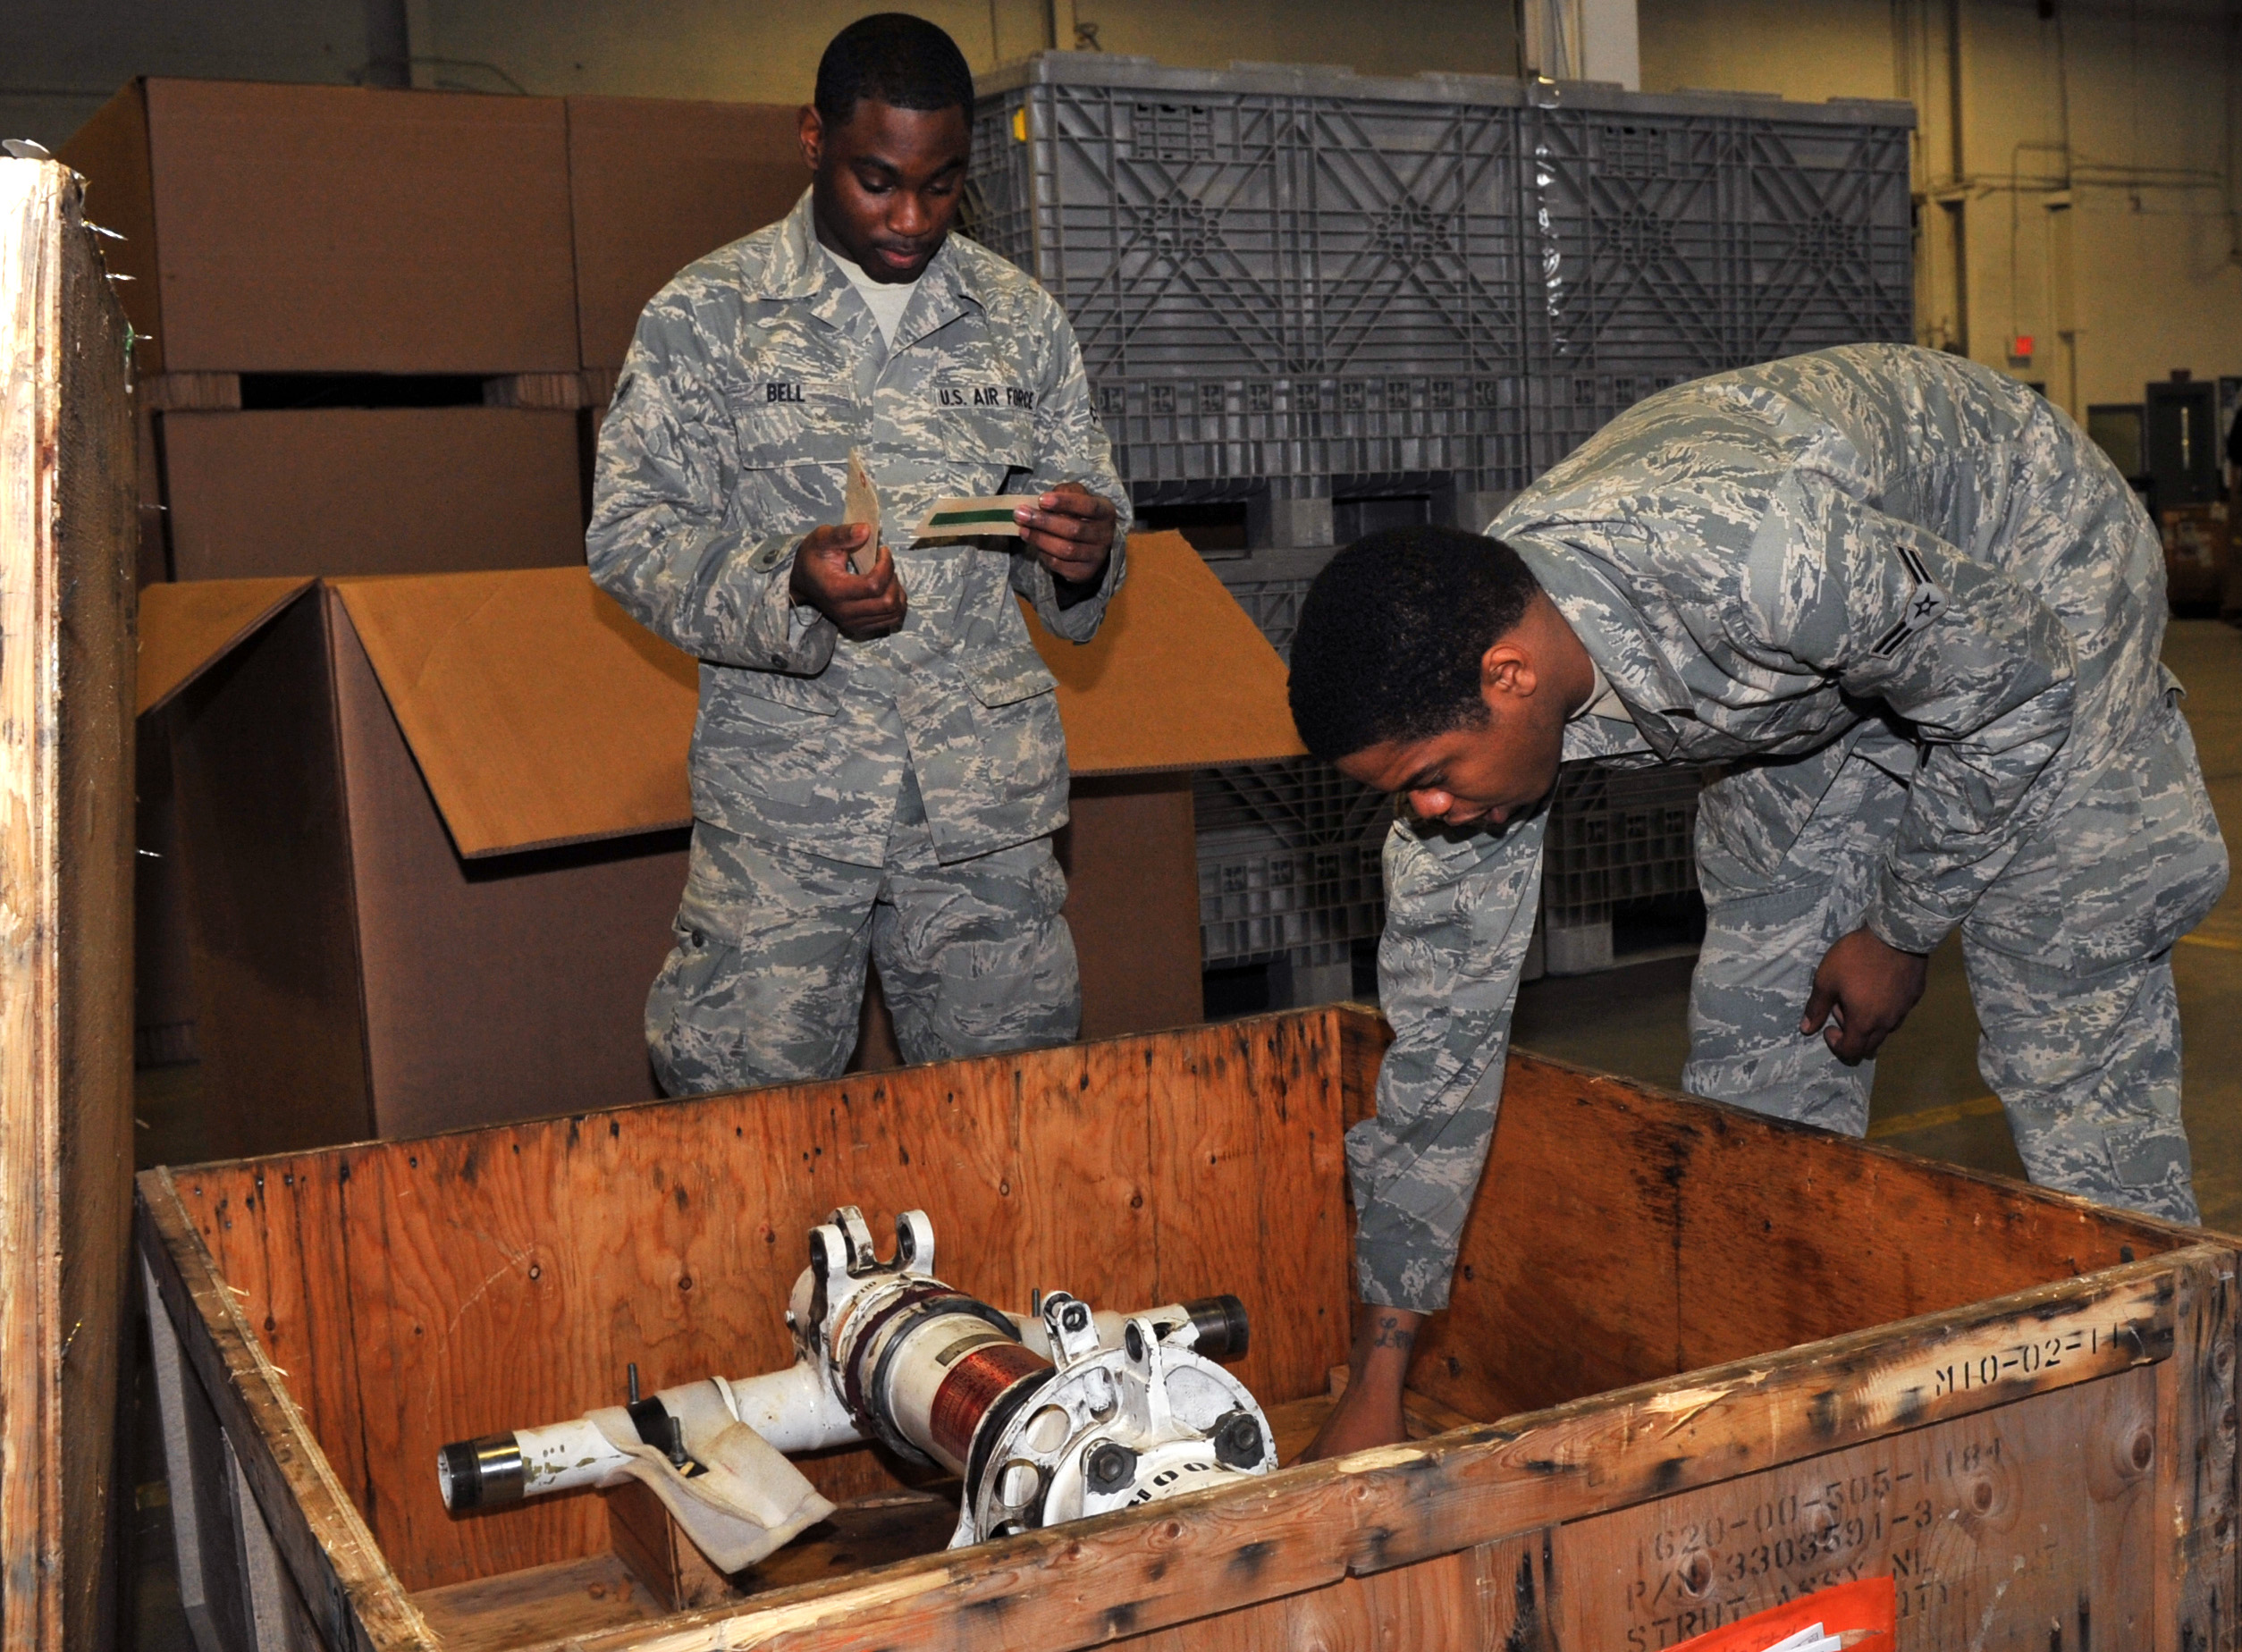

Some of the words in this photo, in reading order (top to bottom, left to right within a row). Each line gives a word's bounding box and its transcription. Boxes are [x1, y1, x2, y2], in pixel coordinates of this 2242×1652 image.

[766, 383, 805, 402] BELL
[940, 388, 967, 406] U.S.
[974, 386, 999, 406] AIR
[1006, 386, 1034, 410] FORCE
